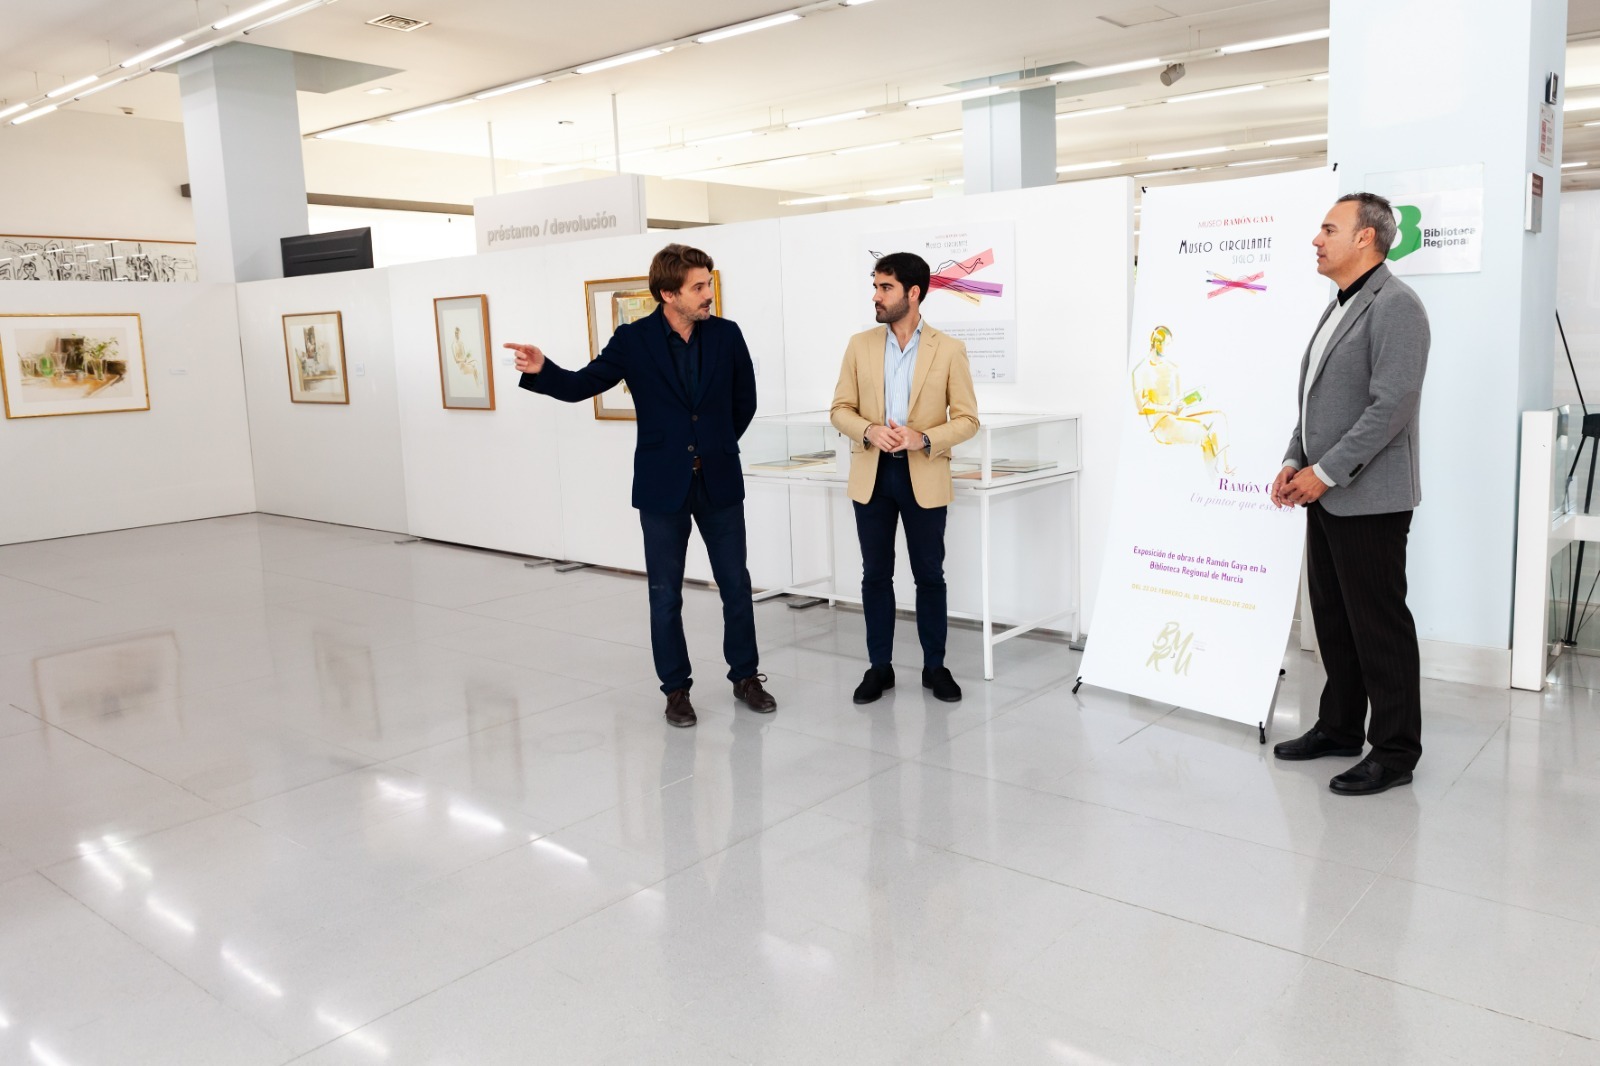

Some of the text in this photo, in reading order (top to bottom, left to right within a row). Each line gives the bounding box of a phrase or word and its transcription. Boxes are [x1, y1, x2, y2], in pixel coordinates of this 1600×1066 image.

[487, 224, 540, 246] préstamo
[550, 210, 617, 235] devolución
[1198, 215, 1275, 229] MUSEO RAMÓN GAYA
[1424, 227, 1476, 238] Biblioteca
[1179, 237, 1272, 254] MUSEO CIRCULANTE
[1232, 254, 1255, 265] SIGLO
[1219, 478, 1260, 494] RAMÓN
[1190, 493, 1203, 504] Un
[1204, 495, 1237, 507] pintor
[1238, 502, 1257, 510] que
[1133, 546, 1166, 558] Exposición
[1167, 552, 1176, 560] de
[1177, 553, 1195, 563] obras
[1196, 556, 1204, 564] de
[1206, 557, 1229, 568] Ramón
[1231, 561, 1248, 572] Gaya
[1260, 565, 1267, 574] la
[1149, 561, 1244, 584] Biblioteca Regional de Murcia
[1159, 588, 1183, 598] FEBRERO
[1210, 597, 1232, 606] MARZO
